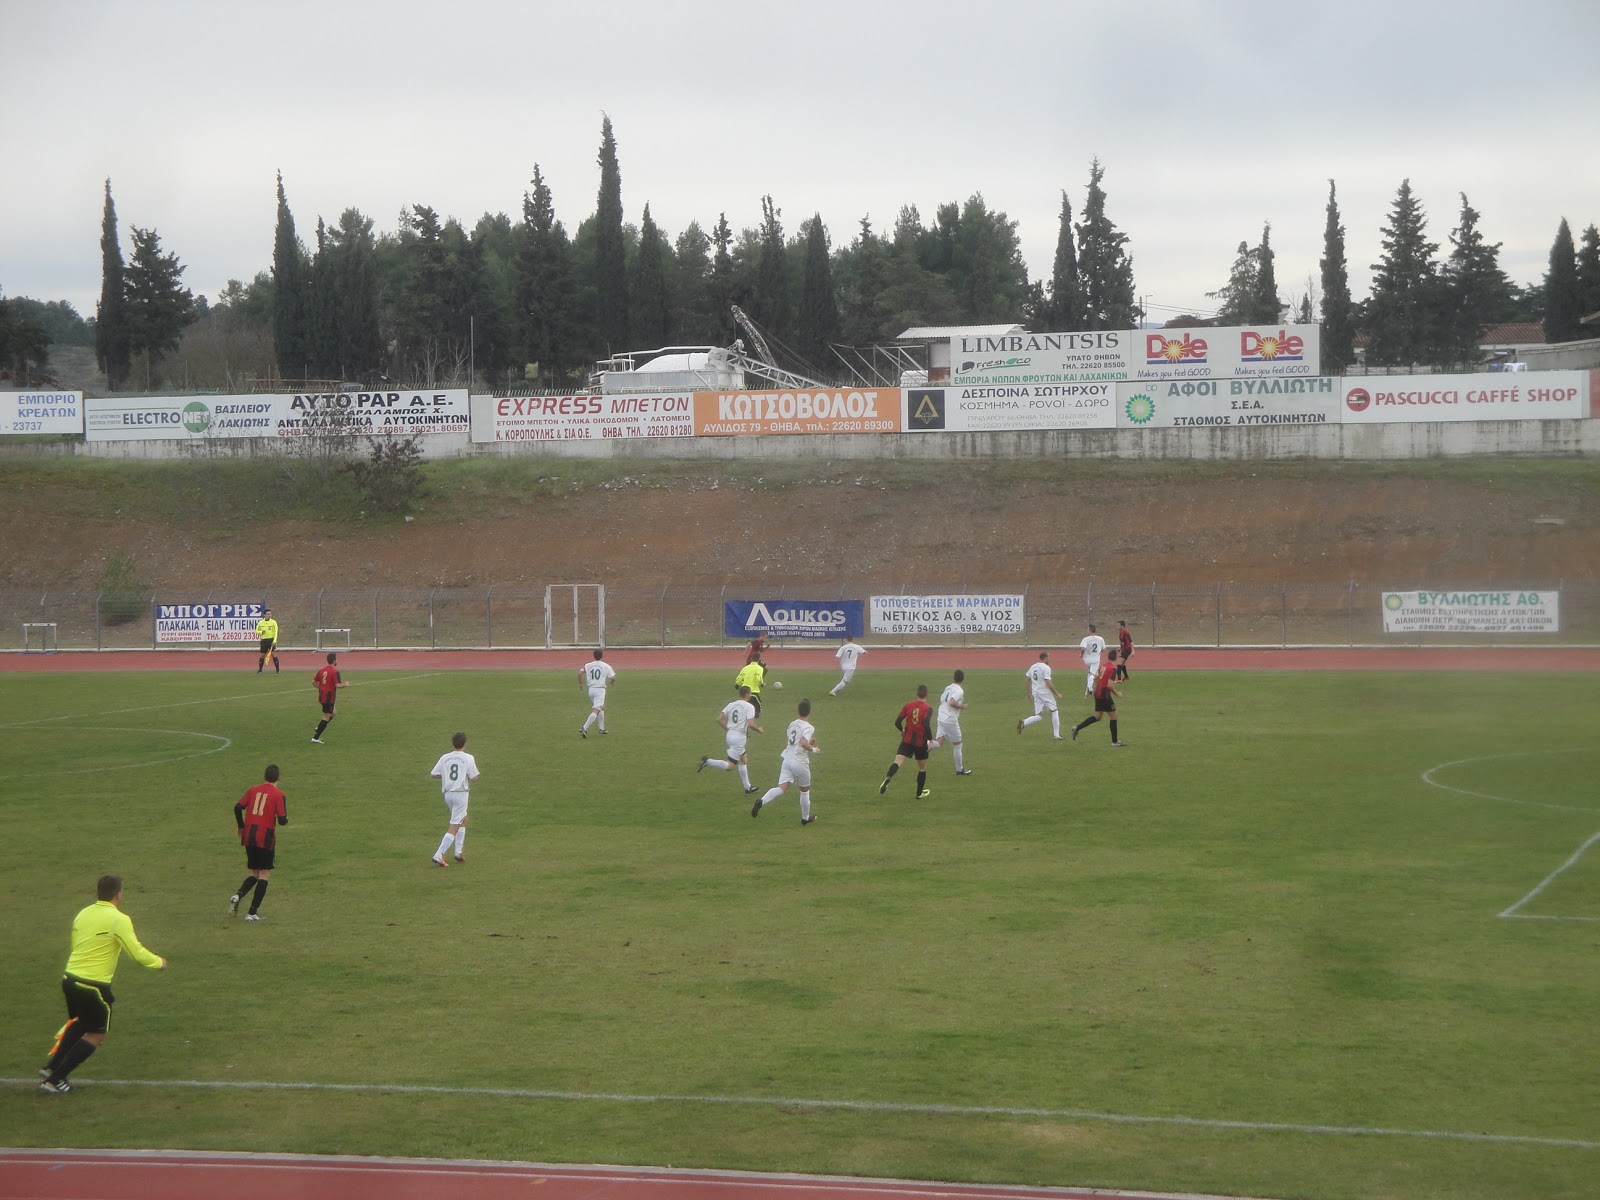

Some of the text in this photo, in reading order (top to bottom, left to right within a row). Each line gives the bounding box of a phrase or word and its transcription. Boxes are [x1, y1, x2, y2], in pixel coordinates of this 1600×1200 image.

[961, 333, 1119, 353] LIMBANTSIS
[1146, 333, 1208, 361] Dole
[1240, 330, 1304, 359] Dole
[1137, 367, 1211, 380] Makes you feel GOOD
[1234, 365, 1310, 378] Makes you feel GOOD
[954, 372, 1128, 385] ΕΜΠΟΡΙΑ ΝΩΠΩΝ ΦΡΟΥΤΩΝ ΚΑΙ ΛΑΧΑΝΙΚΩΝ
[961, 385, 1109, 399] ΔΕΣΠΟΙΝΑ ΣΩΤΗΡΧΟΥ
[1145, 383, 1158, 393] bp
[1167, 378, 1333, 397] ΑΦΟΙ ΒΥΛΛΙΩΤΗ
[18, 394, 76, 405] ΕΜΠΟΡΙΟ
[409, 395, 454, 406] Α.Ε.
[1375, 385, 1578, 406] PASCUCCI CAFFÉ SHOP
[215, 404, 272, 414] ΒΑΣΙΛΕΙΟΥ
[497, 397, 690, 417] EXPRESS ΜΠΕΤΟΝ
[718, 392, 878, 421] ΚΩΤΣΟΒΟΛΟΣ
[960, 401, 1020, 411] ΚΟΣΜΗΜΑ
[1075, 399, 1109, 408] ΔΩΡΟ
[1230, 400, 1264, 410] Σ.Ε.Α.
[18, 407, 76, 418] ΚΡΕΑΤΩΝ
[123, 411, 181, 426] ELECTRO
[13, 421, 43, 431] 23737
[217, 418, 270, 429] ΛΑΚΙΩΤΗΣ
[384, 415, 468, 426] ΑΥΤΟΚΙΝΗΤΩΝ
[1173, 413, 1326, 426] ΣΤΑΘΜΟΣ ΑΥΤΟΚΙΝΗΤΩΝ
[377, 426, 404, 434] 27089
[496, 430, 504, 441] Κ.
[505, 429, 555, 441] ΚΟΡΟΠΟΥΛΗΣ
[564, 428, 577, 439] ΣΙΑ
[578, 428, 592, 439] Ο.Ε.
[602, 427, 623, 438] ΘΗΒΑ
[626, 426, 644, 437] ΤΗΛ.
[647, 426, 669, 437] 22620
[670, 425, 692, 436] 81280
[703, 422, 747, 433] ΑΥΛΙΔΟΣ
[749, 422, 761, 433] 79
[770, 422, 803, 434] ΘΗΒΑ,
[832, 421, 862, 432] 22620
[864, 419, 894, 431] 89300
[874, 597, 1020, 608] ΤΟΠΟΘΕΤΗΣΕΙΣ ΜΑΡΜΑΡΩΝ
[1418, 592, 1511, 606] ΒΥΛΛΙΩΤΗΣ
[1516, 592, 1544, 606] ΑΘ.
[160, 604, 262, 618] ΜΠΟΓΡΗΣ
[882, 610, 1013, 621] ΝΕΤΙΚΟΣ ΑΘ. & ΥΙΟΣ
[1401, 608, 1436, 616] ΣΤΑΘΜΟΣ
[158, 620, 200, 632] ΠΛΑΚΑΚΙΑ
[206, 620, 225, 631] ΕΙΔΗ
[1394, 617, 1430, 625] ΔΙΑΝΟΜΗ
[892, 624, 914, 633] 6972
[960, 624, 983, 633] 6982
[986, 624, 1021, 633] 074029
[222, 631, 242, 640] 22620
[846, 649, 852, 659] 7
[1091, 643, 1098, 653] 2
[322, 670, 328, 685] 2
[590, 668, 601, 681] 10
[1033, 670, 1038, 681] 5
[731, 709, 739, 724] 6
[789, 729, 797, 746] 3
[449, 763, 459, 781] 8
[252, 791, 268, 816] 11
